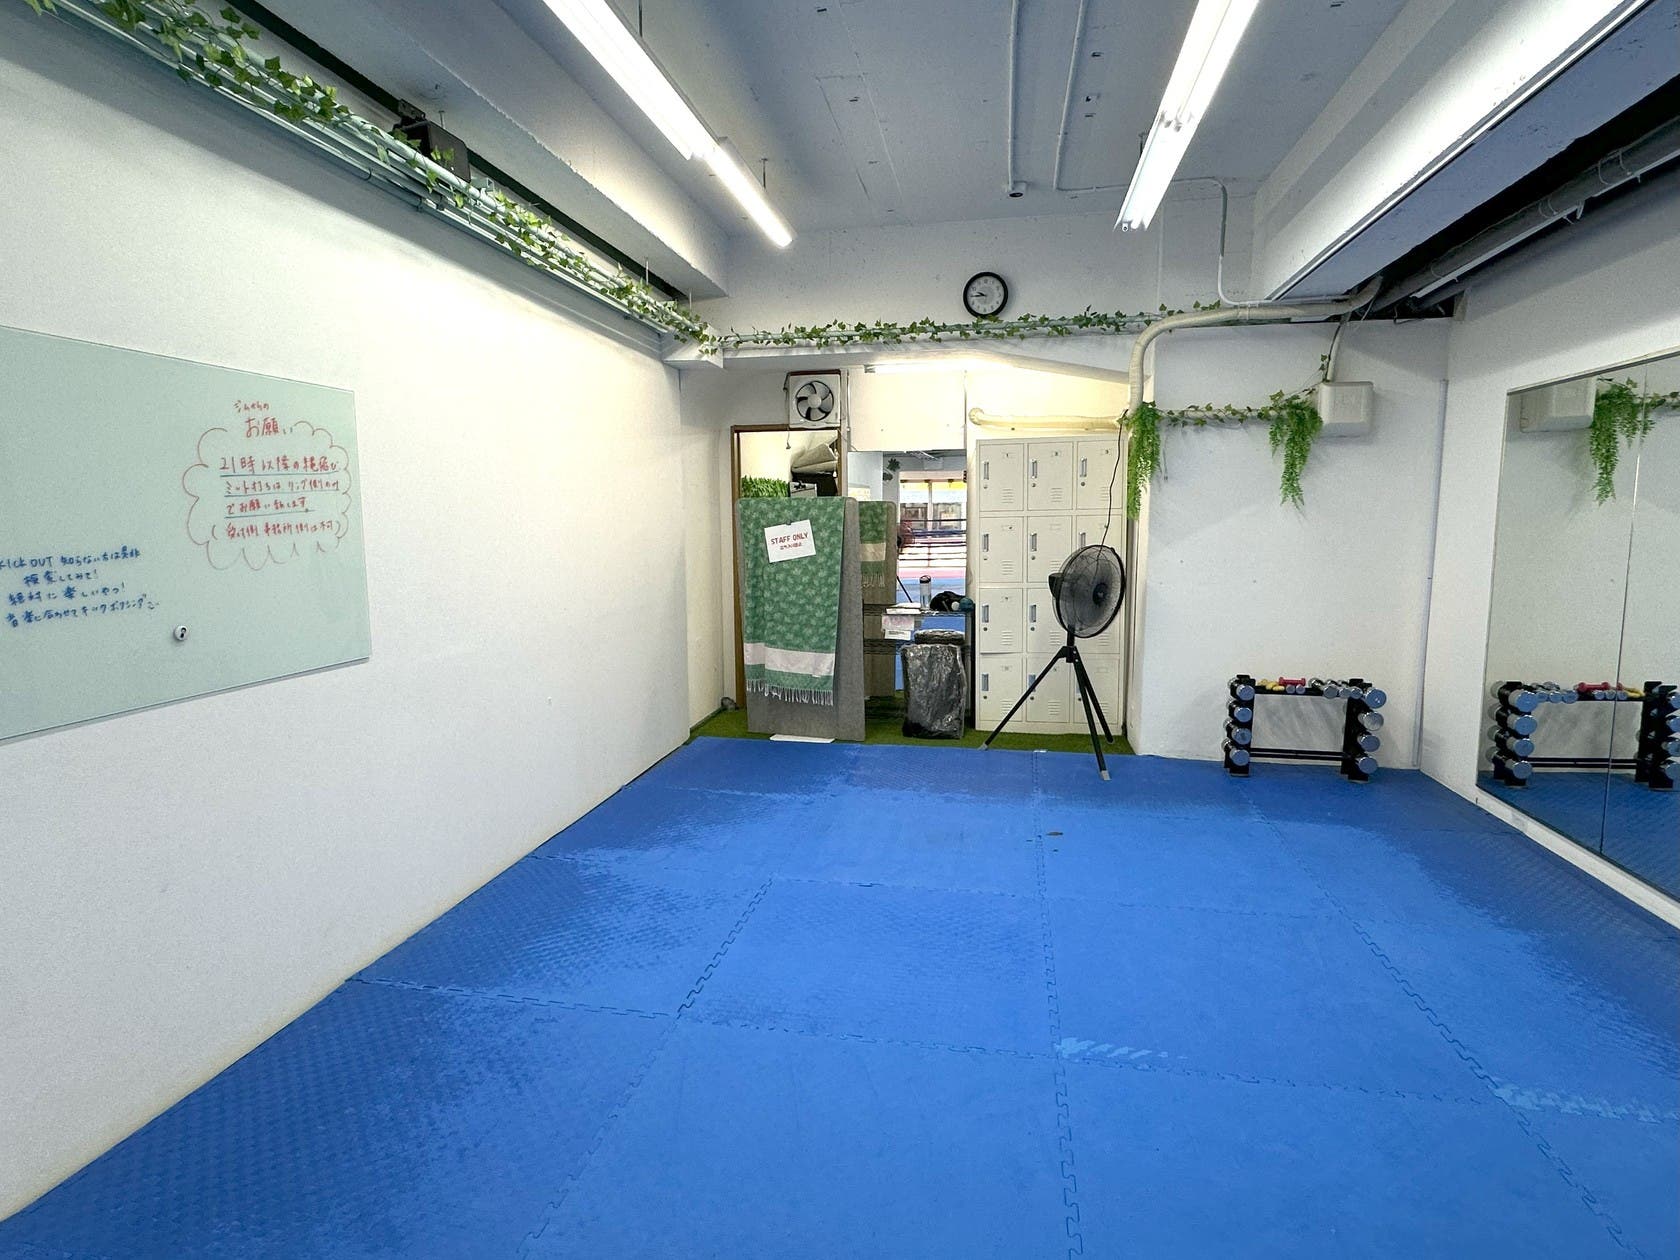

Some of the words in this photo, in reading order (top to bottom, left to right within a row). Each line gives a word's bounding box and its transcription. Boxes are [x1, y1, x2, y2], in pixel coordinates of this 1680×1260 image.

[244, 416, 293, 438] お願い
[770, 535, 791, 545] STAFF
[792, 531, 809, 541] ONLY
[30, 555, 53, 568] OUT
